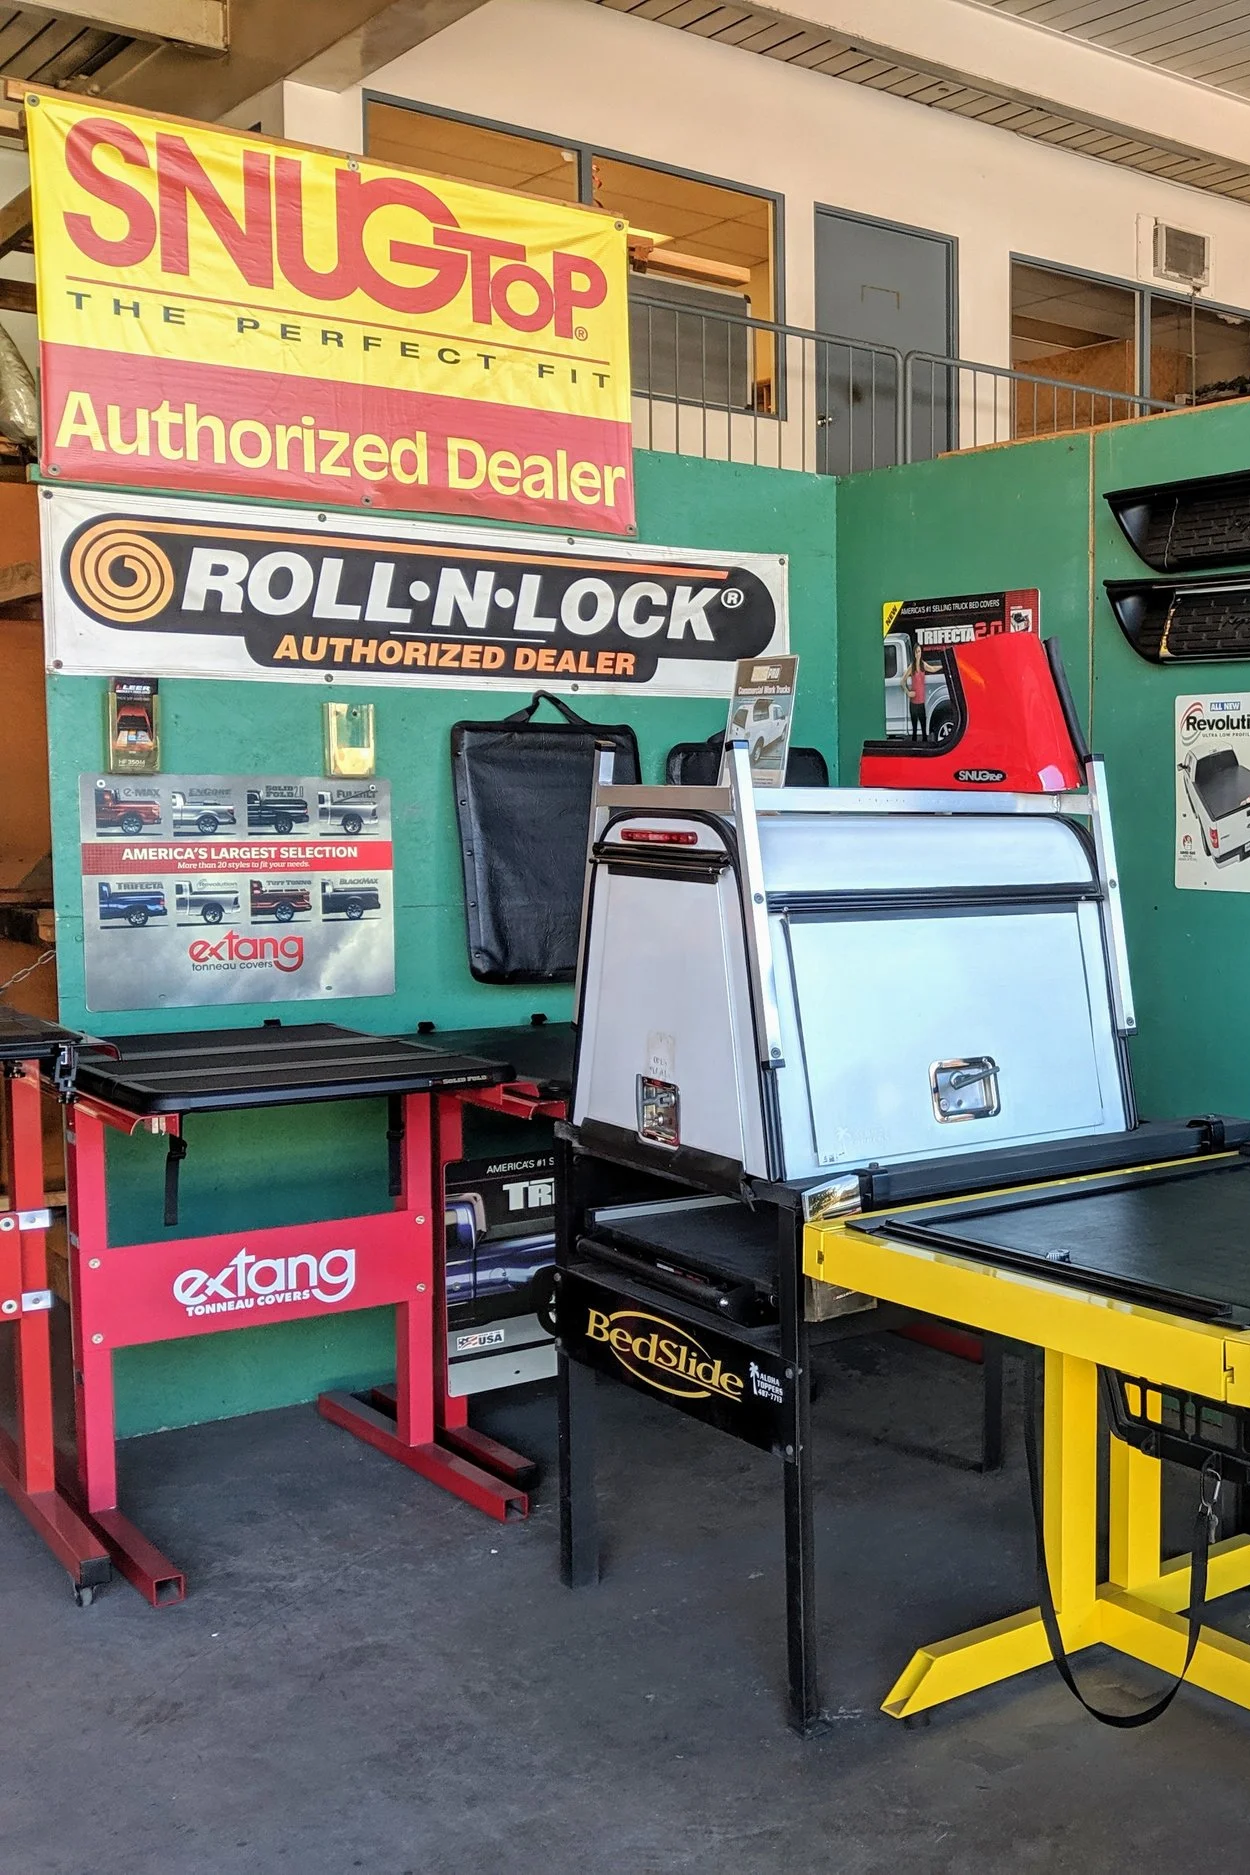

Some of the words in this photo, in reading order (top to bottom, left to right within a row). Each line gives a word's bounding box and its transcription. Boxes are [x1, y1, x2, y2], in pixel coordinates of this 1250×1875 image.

[66, 291, 186, 326] THE
[238, 316, 497, 371] PERFECT
[538, 363, 611, 389] FIT
[55, 390, 429, 486] Authorized
[448, 437, 626, 507] Dealer
[901, 605, 926, 615] AMERICA'S
[932, 602, 953, 612] SELLING
[953, 601, 969, 611] TRUCK
[969, 601, 980, 610] BED
[980, 599, 1000, 608] COVERS
[885, 605, 898, 627] NEW
[915, 624, 976, 646] TRIFECTA
[273, 634, 504, 671] AUTHORIZED
[514, 646, 636, 676] DEALER
[1210, 702, 1223, 711] ALL
[1223, 701, 1240, 711] NEW
[122, 848, 208, 860] AMERICA'S
[210, 847, 277, 860] LARGEST
[279, 846, 358, 859] SELECTION
[198, 861, 216, 869] than
[227, 861, 250, 870] styles
[259, 861, 268, 870] fit
[269, 862, 286, 870] your
[116, 882, 164, 890] TRIFECTA
[188, 929, 305, 972] extang
[192, 962, 237, 972] tonneau
[240, 960, 274, 970] covers
[486, 1160, 535, 1174] AMERICA'S
[173, 1247, 356, 1306] extang
[186, 1298, 254, 1317] TONNEAU
[256, 1289, 311, 1306] COVERS
[478, 1333, 503, 1345] USA
[757, 1379, 783, 1396] TOPPERS
[760, 1372, 781, 1387] ALOHA
